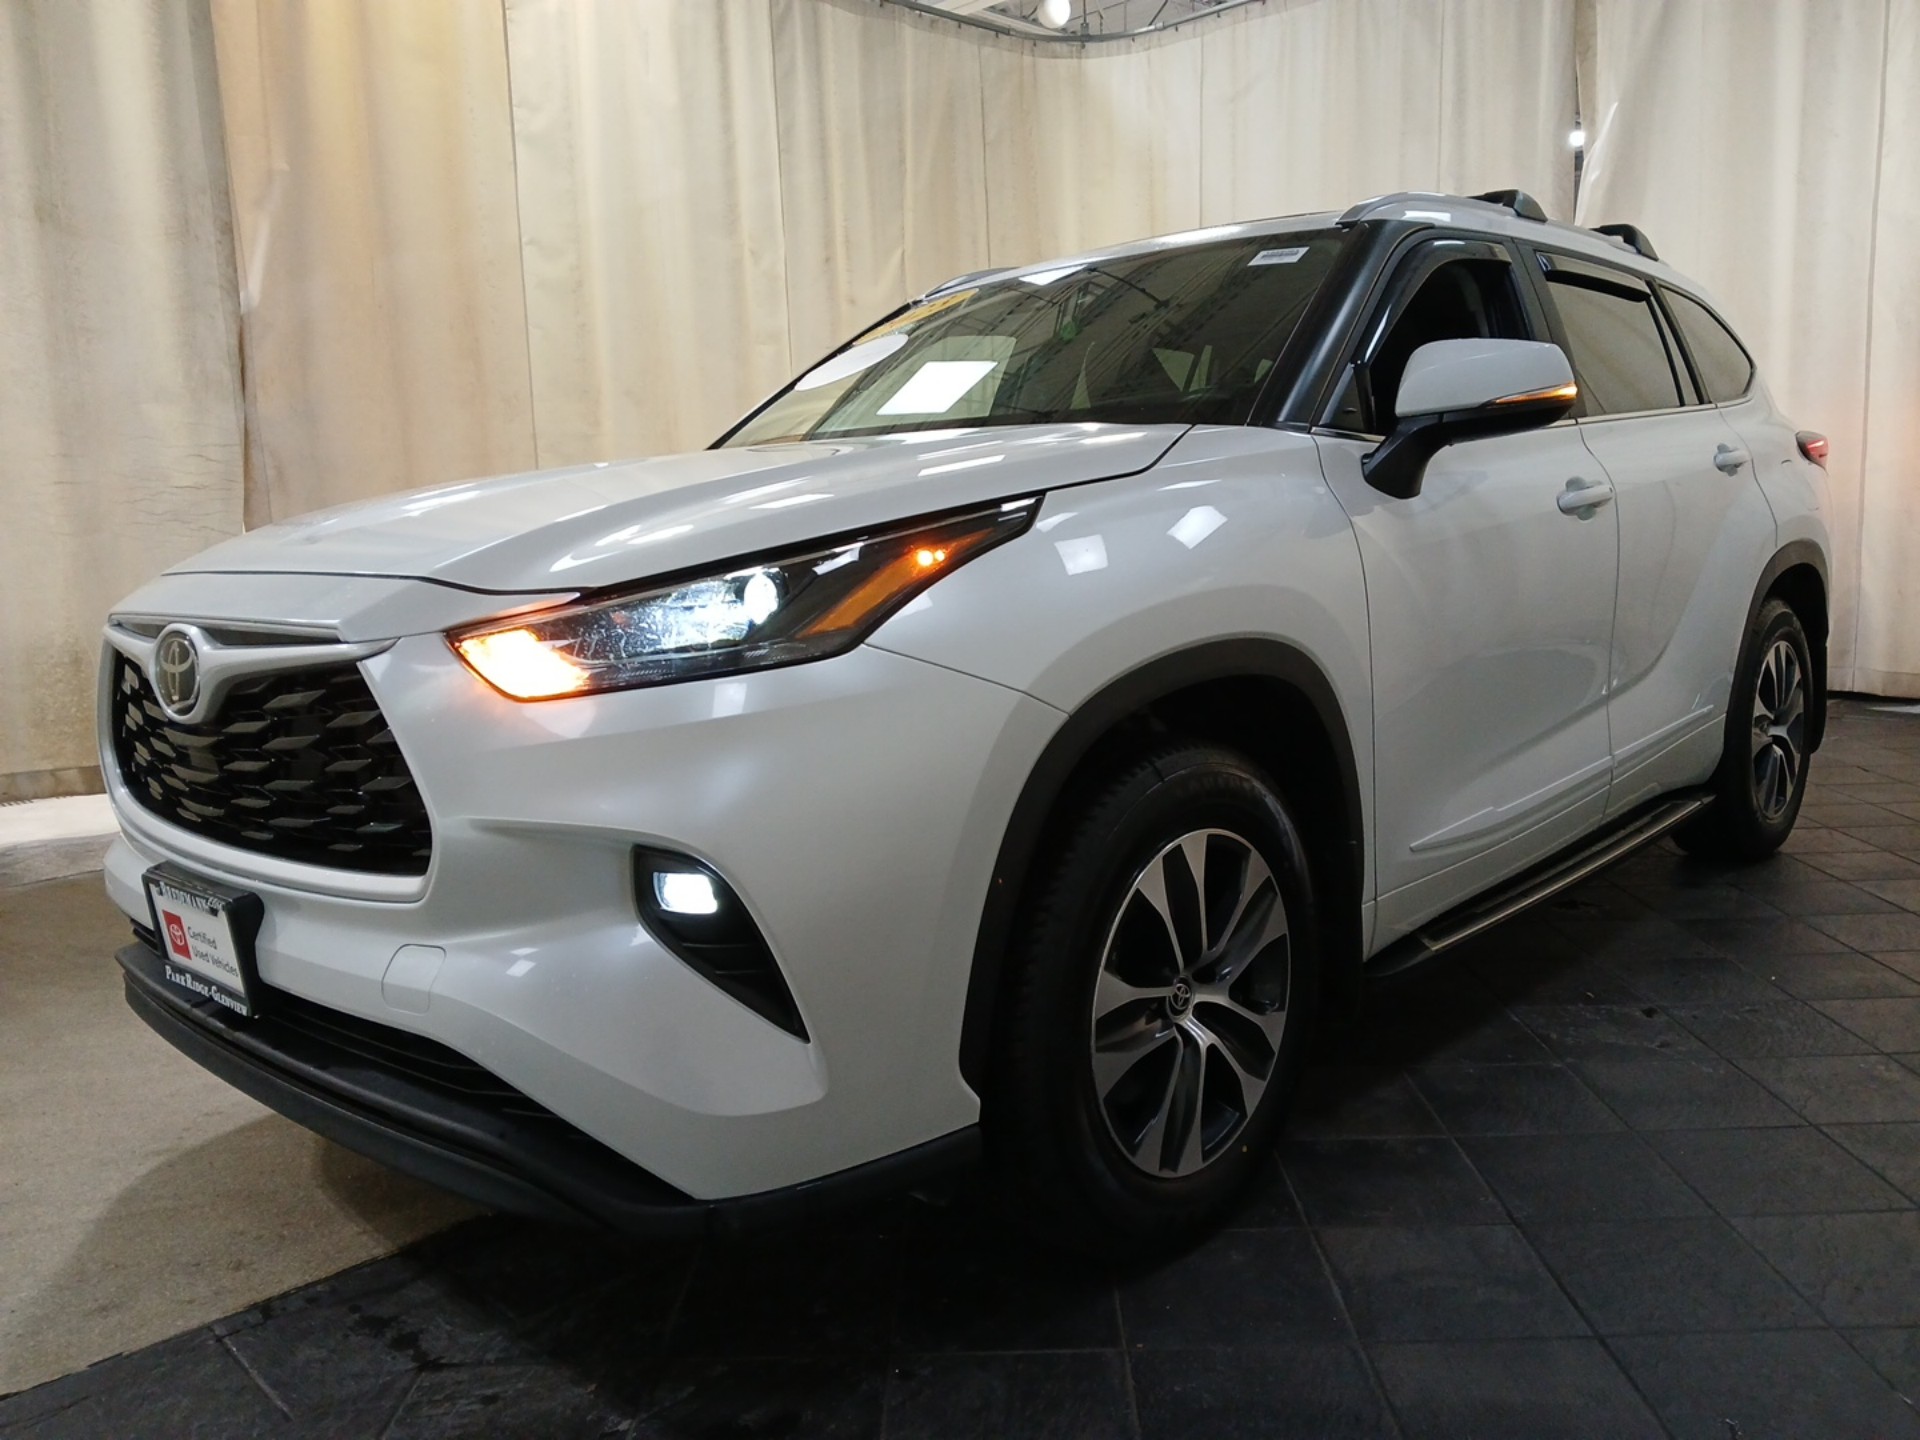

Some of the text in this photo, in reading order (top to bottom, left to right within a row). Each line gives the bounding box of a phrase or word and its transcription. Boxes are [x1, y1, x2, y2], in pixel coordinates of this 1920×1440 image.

[187, 926, 217, 950] Certified
[191, 945, 239, 977] Used Vehicles
